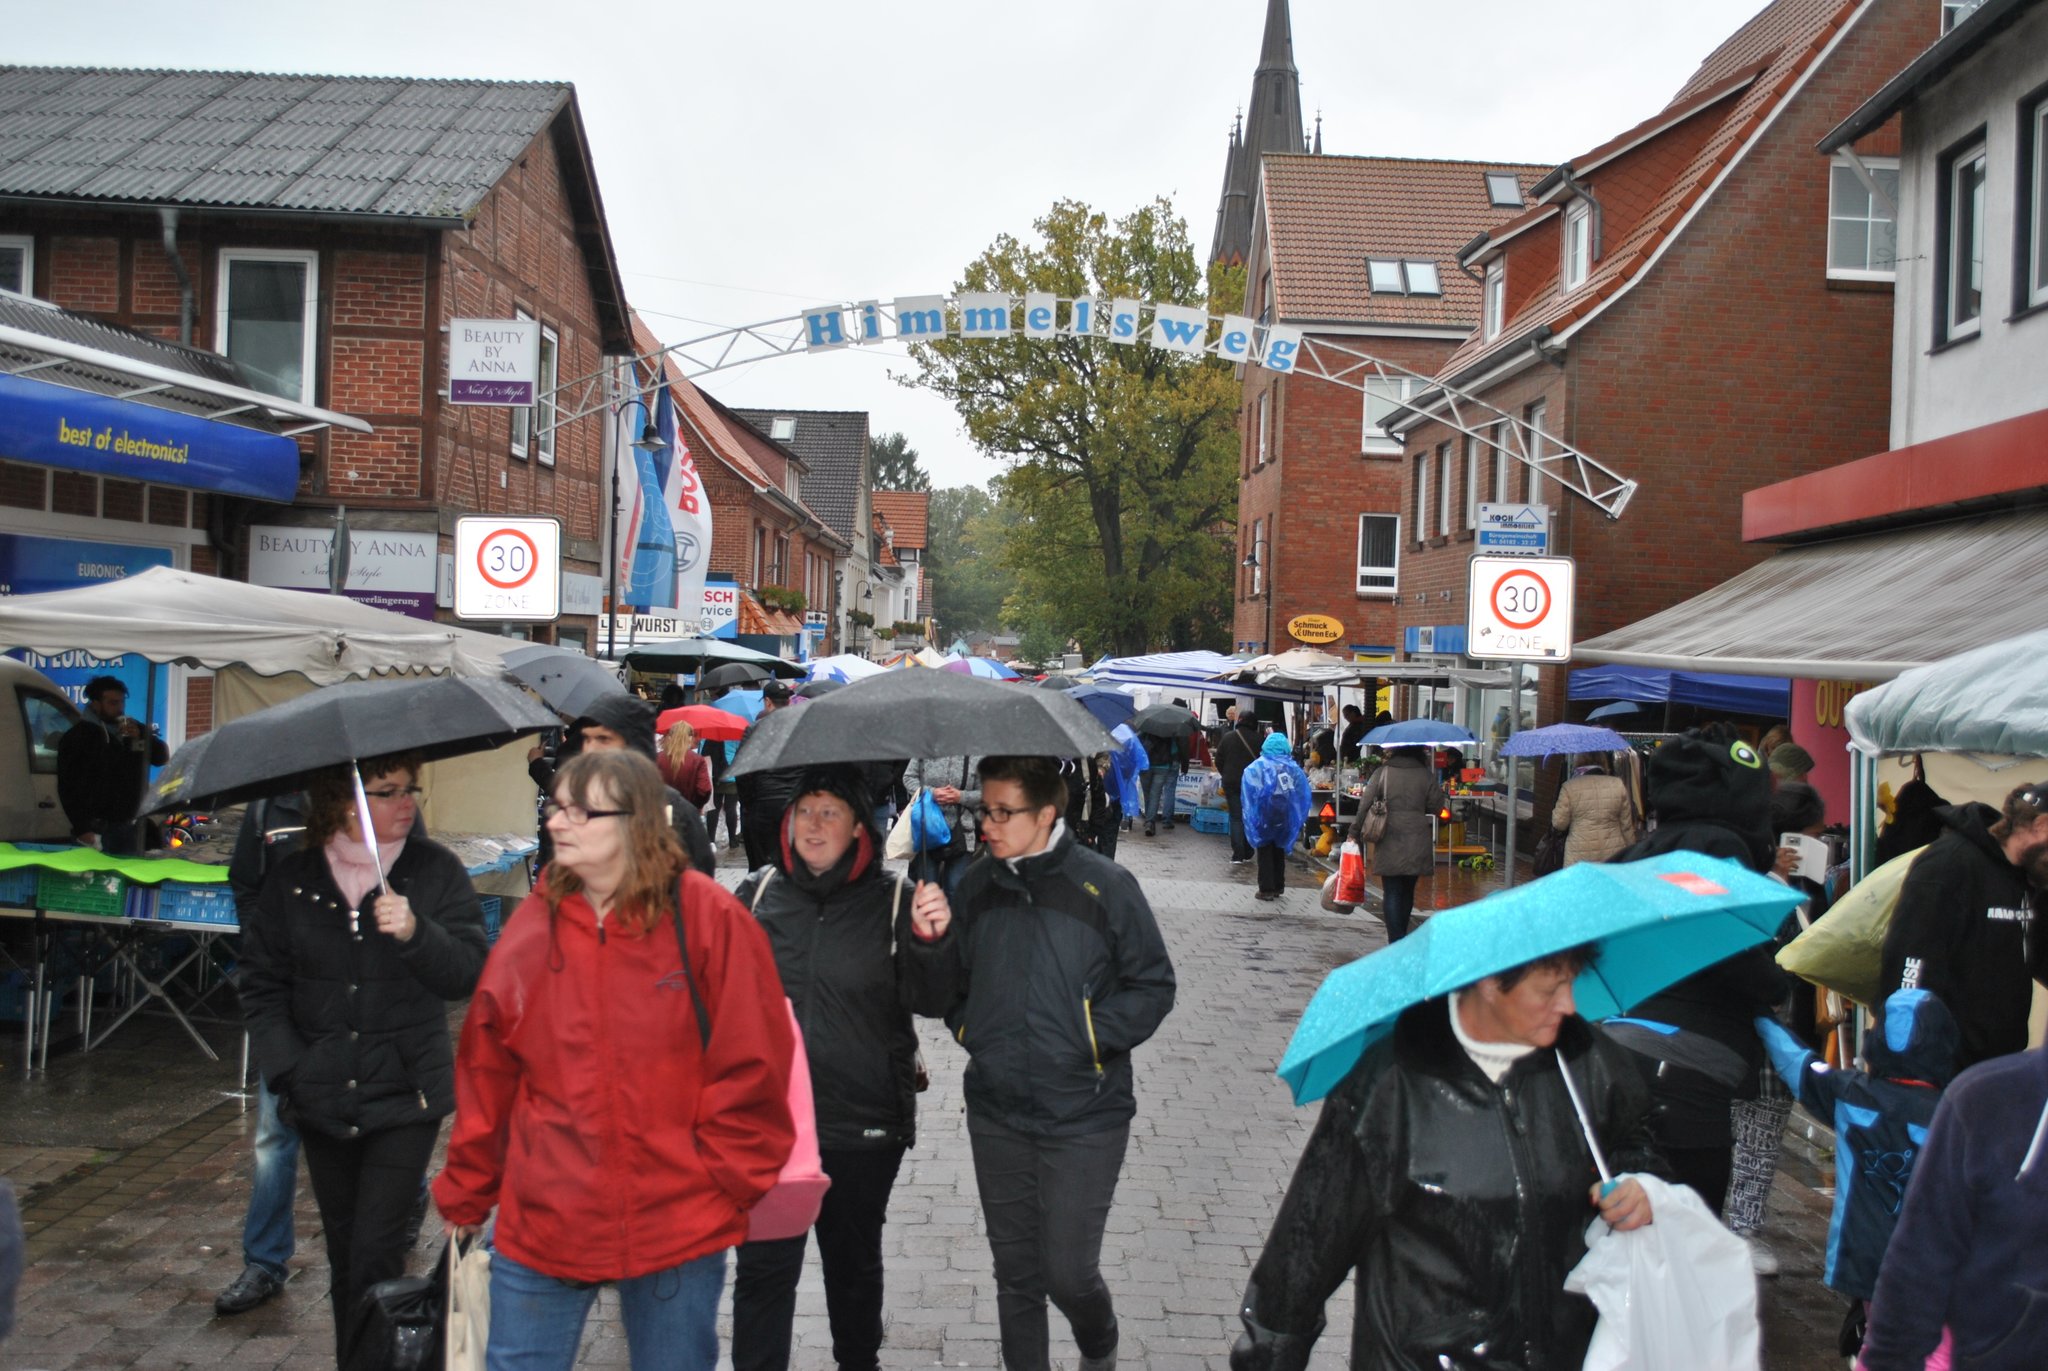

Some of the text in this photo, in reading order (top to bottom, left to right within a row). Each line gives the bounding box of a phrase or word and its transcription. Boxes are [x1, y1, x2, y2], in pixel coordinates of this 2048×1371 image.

[464, 328, 524, 344] BEAUTY
[806, 303, 1298, 371] Himmelsweg
[484, 345, 503, 358] BY
[468, 359, 517, 374] ANNA
[59, 417, 189, 465] best of electronics!
[1489, 514, 1514, 523] KOCH
[259, 534, 427, 558] BEAUTY Y ANNA
[490, 545, 525, 572] 30
[78, 562, 126, 578] EURONICS
[301, 563, 329, 576] Nai
[484, 594, 531, 609] ZONE
[704, 590, 733, 603] SCH
[1503, 585, 1538, 613] 30
[700, 603, 733, 616] rvice
[634, 618, 678, 633] WURST
[1293, 620, 1328, 630] Schmuck
[1302, 629, 1325, 638] Uhren
[1325, 630, 1338, 638] Eck
[1496, 635, 1542, 650] ZONE
[1901, 957, 1921, 990] EISE
